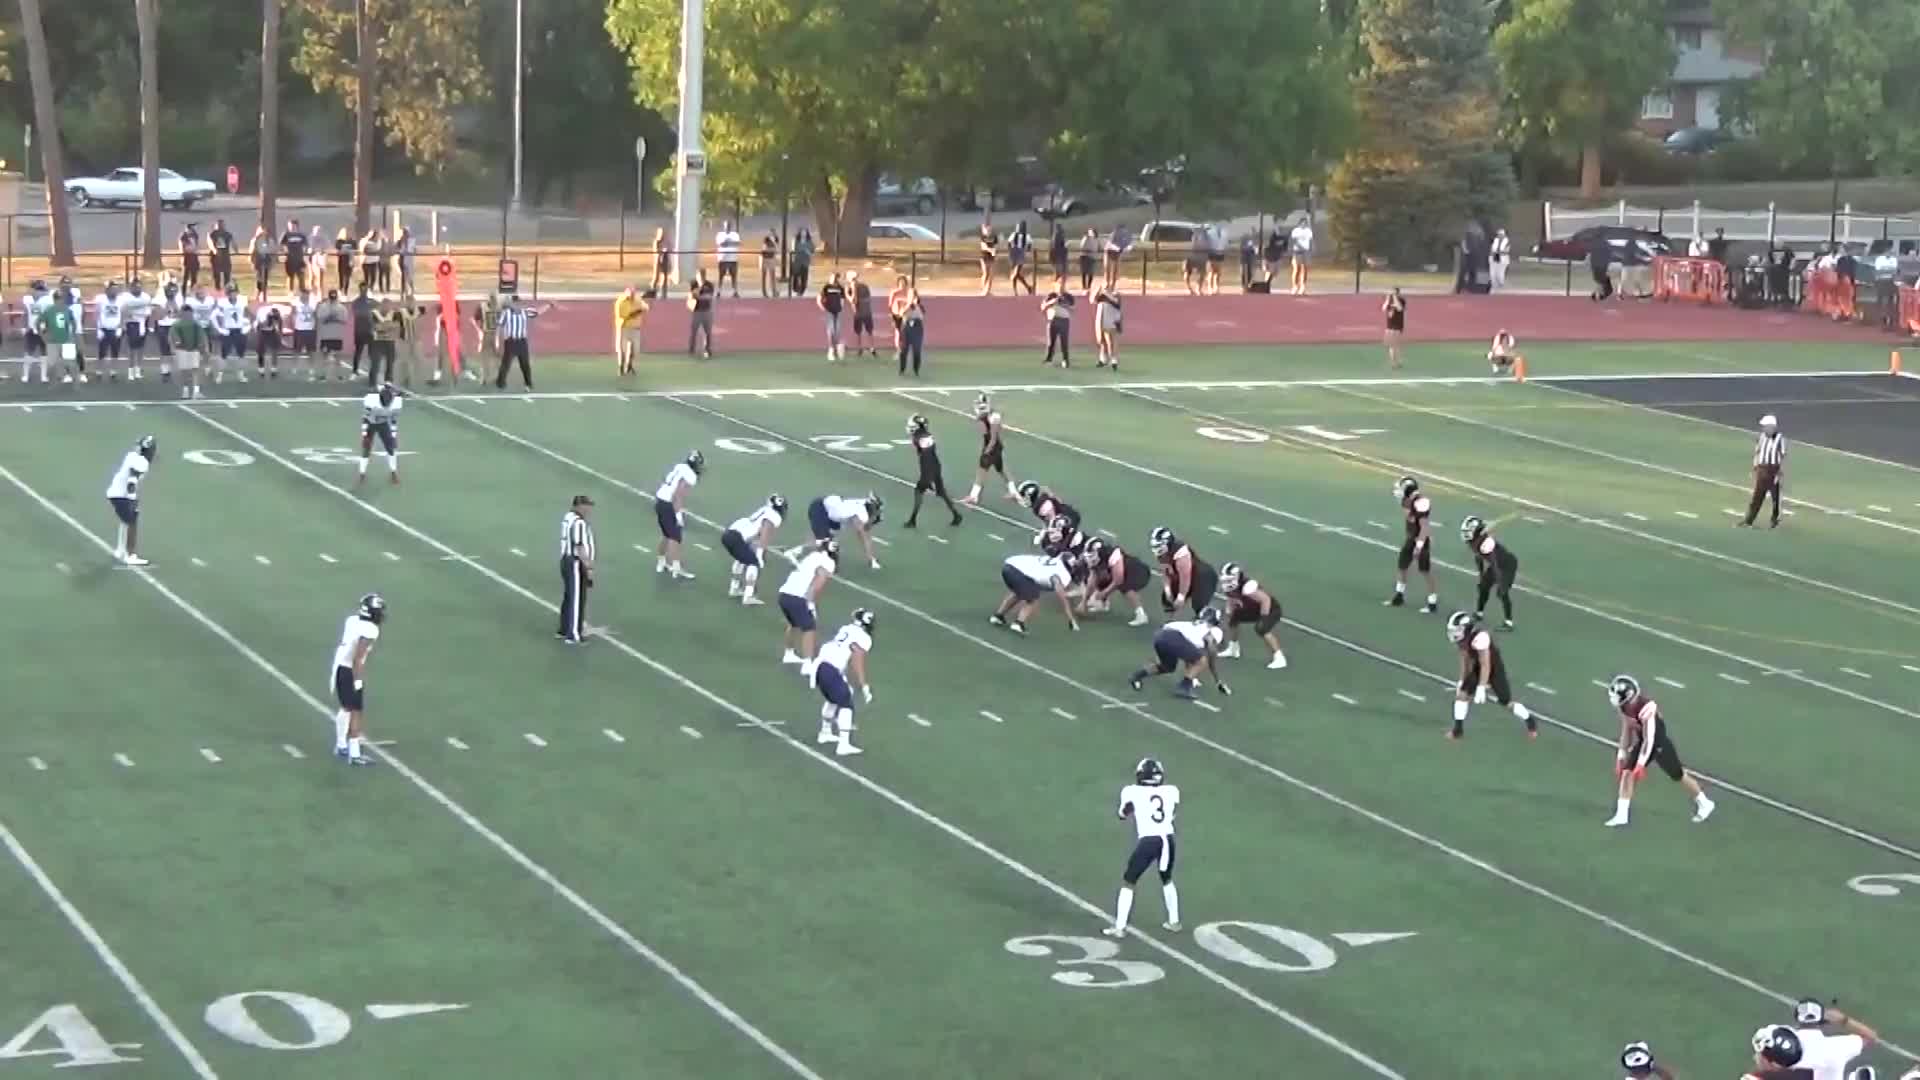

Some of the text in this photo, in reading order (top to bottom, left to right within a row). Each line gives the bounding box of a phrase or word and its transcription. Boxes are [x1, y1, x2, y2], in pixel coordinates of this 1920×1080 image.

[1150, 795, 1165, 824] 3
[1004, 920, 1338, 988] 30
[0, 990, 352, 1068] 40
